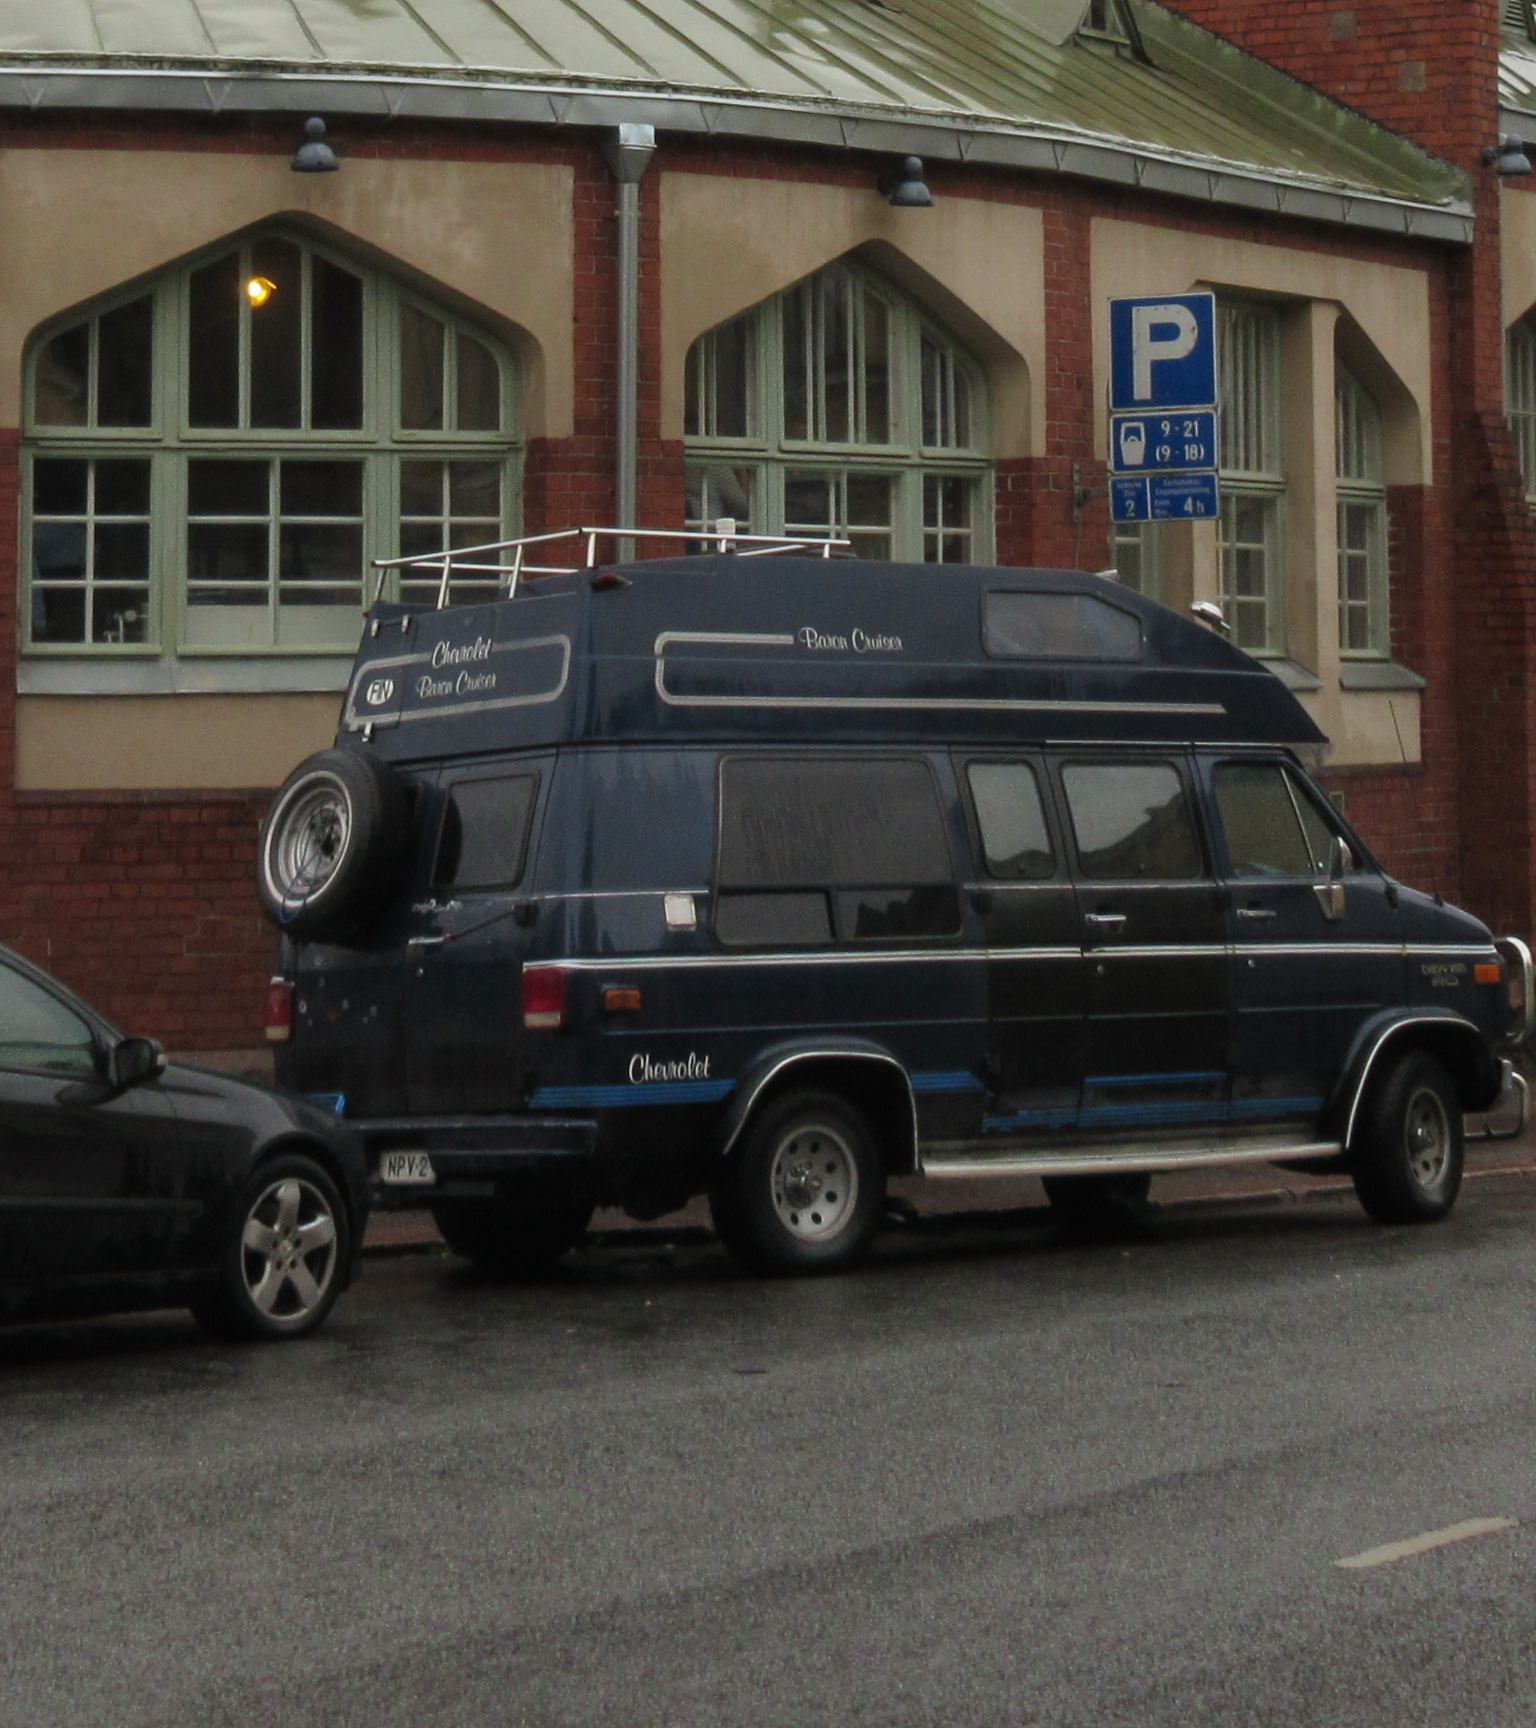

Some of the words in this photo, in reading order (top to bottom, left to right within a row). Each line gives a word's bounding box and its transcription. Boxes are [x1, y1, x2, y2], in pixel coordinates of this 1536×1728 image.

[1132, 303, 1198, 401] P
[1125, 500, 1135, 517] 2
[1183, 497, 1193, 514] 4
[1196, 500, 1205, 513] h
[431, 635, 493, 669] Chevrolet
[798, 626, 848, 650] Baron
[851, 627, 904, 653] Cruiser
[368, 680, 392, 703] FIN
[415, 675, 453, 699] Baron
[455, 670, 497, 695] Cruiser
[628, 1051, 711, 1084] Chevrolet
